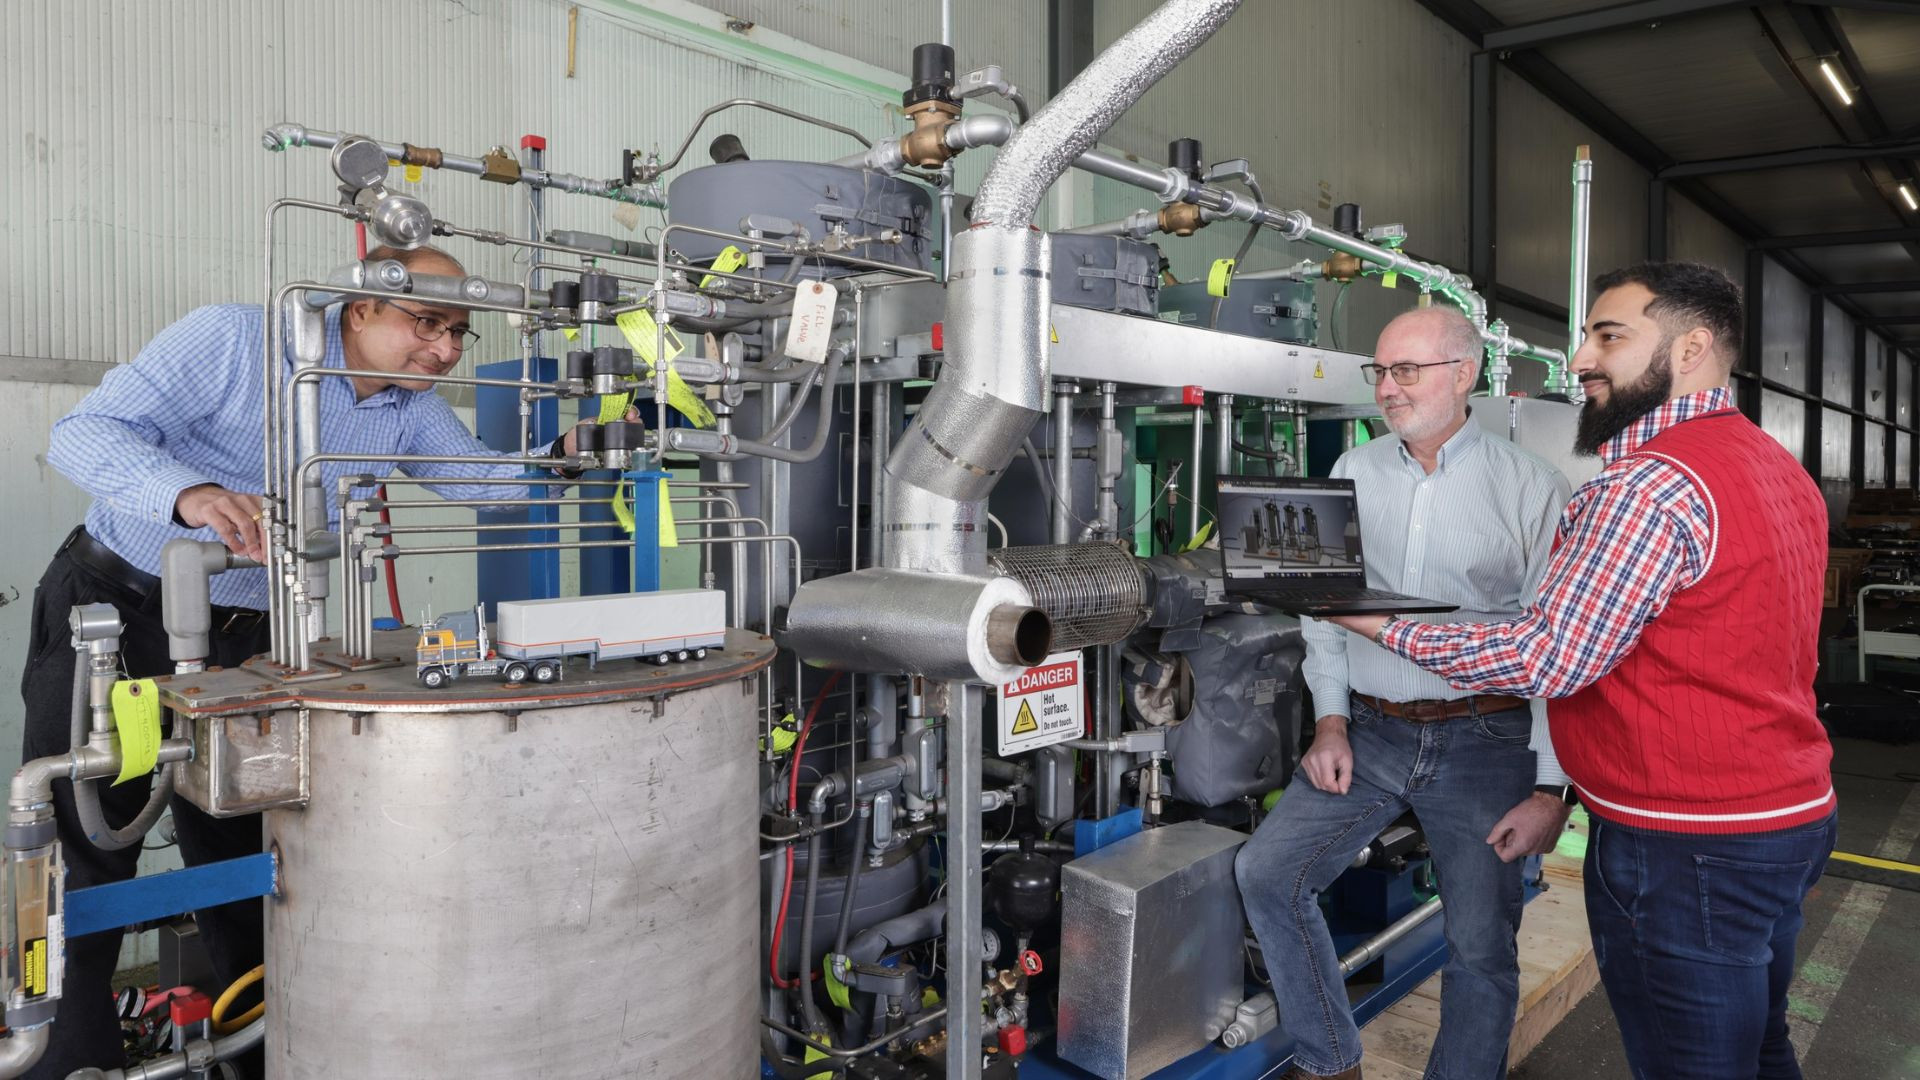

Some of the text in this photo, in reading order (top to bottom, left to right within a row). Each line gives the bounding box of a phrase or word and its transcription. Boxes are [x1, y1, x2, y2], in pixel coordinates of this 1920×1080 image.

[1021, 667, 1073, 689] DANGER
[1043, 693, 1055, 704] Hot
[1043, 703, 1070, 716] surface.
[1044, 721, 1050, 730] Do
[1059, 717, 1073, 727] touch.
[25, 950, 33, 988] WARNING
